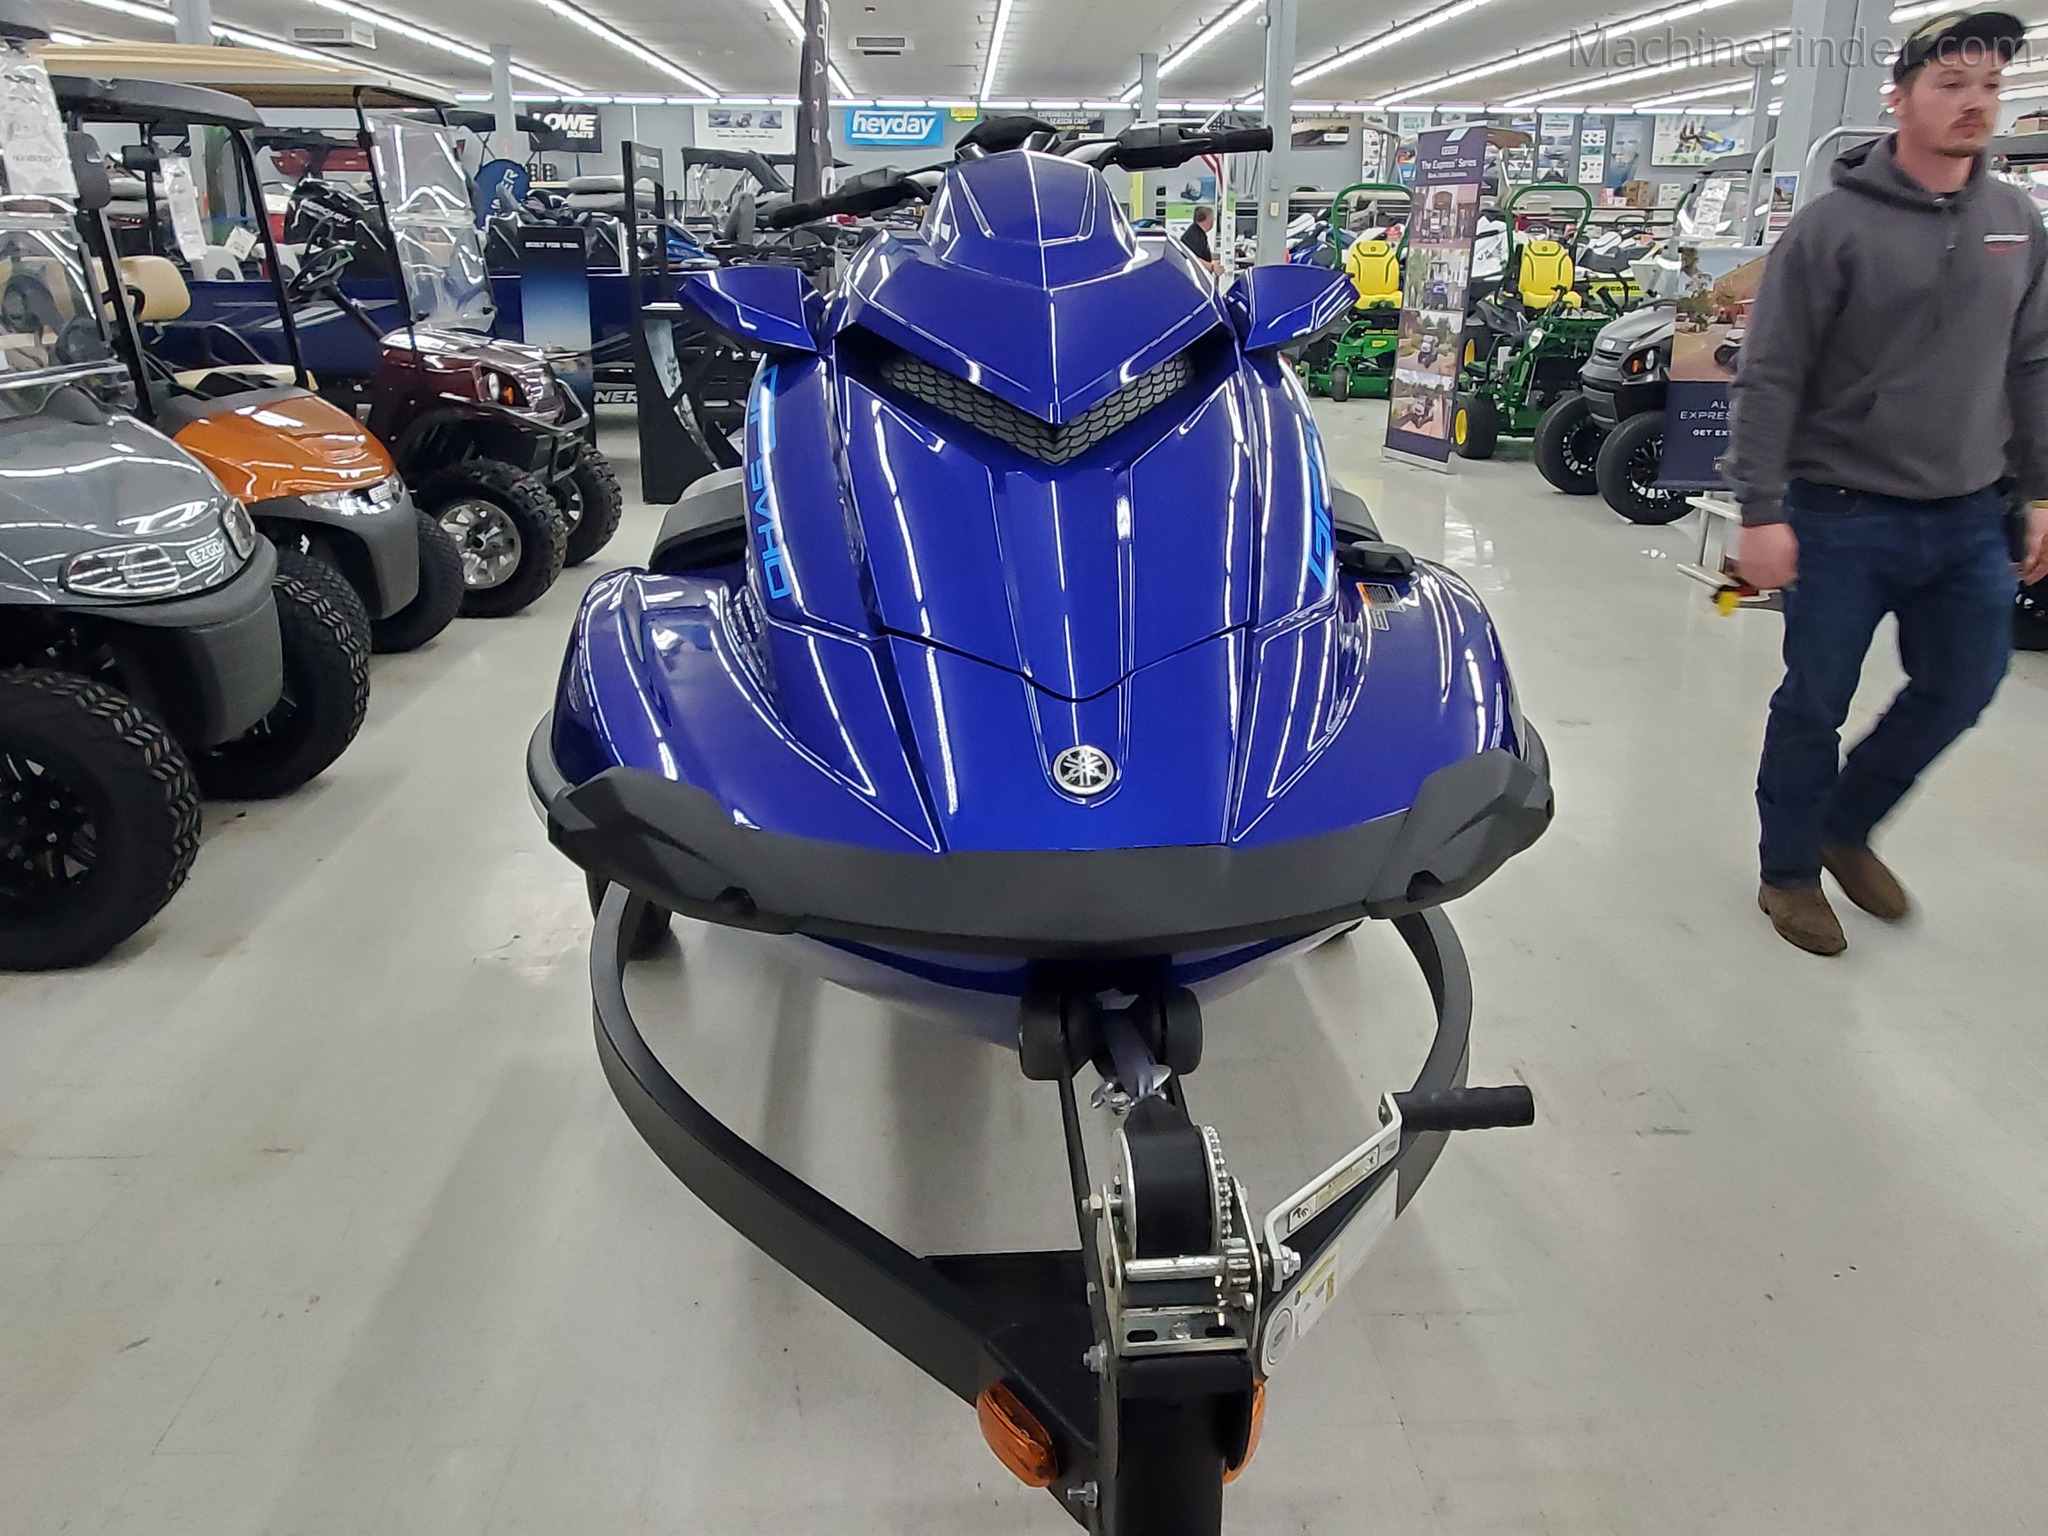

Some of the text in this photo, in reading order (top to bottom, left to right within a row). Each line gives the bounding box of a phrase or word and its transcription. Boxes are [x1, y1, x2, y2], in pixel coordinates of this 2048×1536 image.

[852, 110, 937, 140] heyday
[566, 130, 595, 139] BOATS
[1692, 429, 1712, 437] GET
